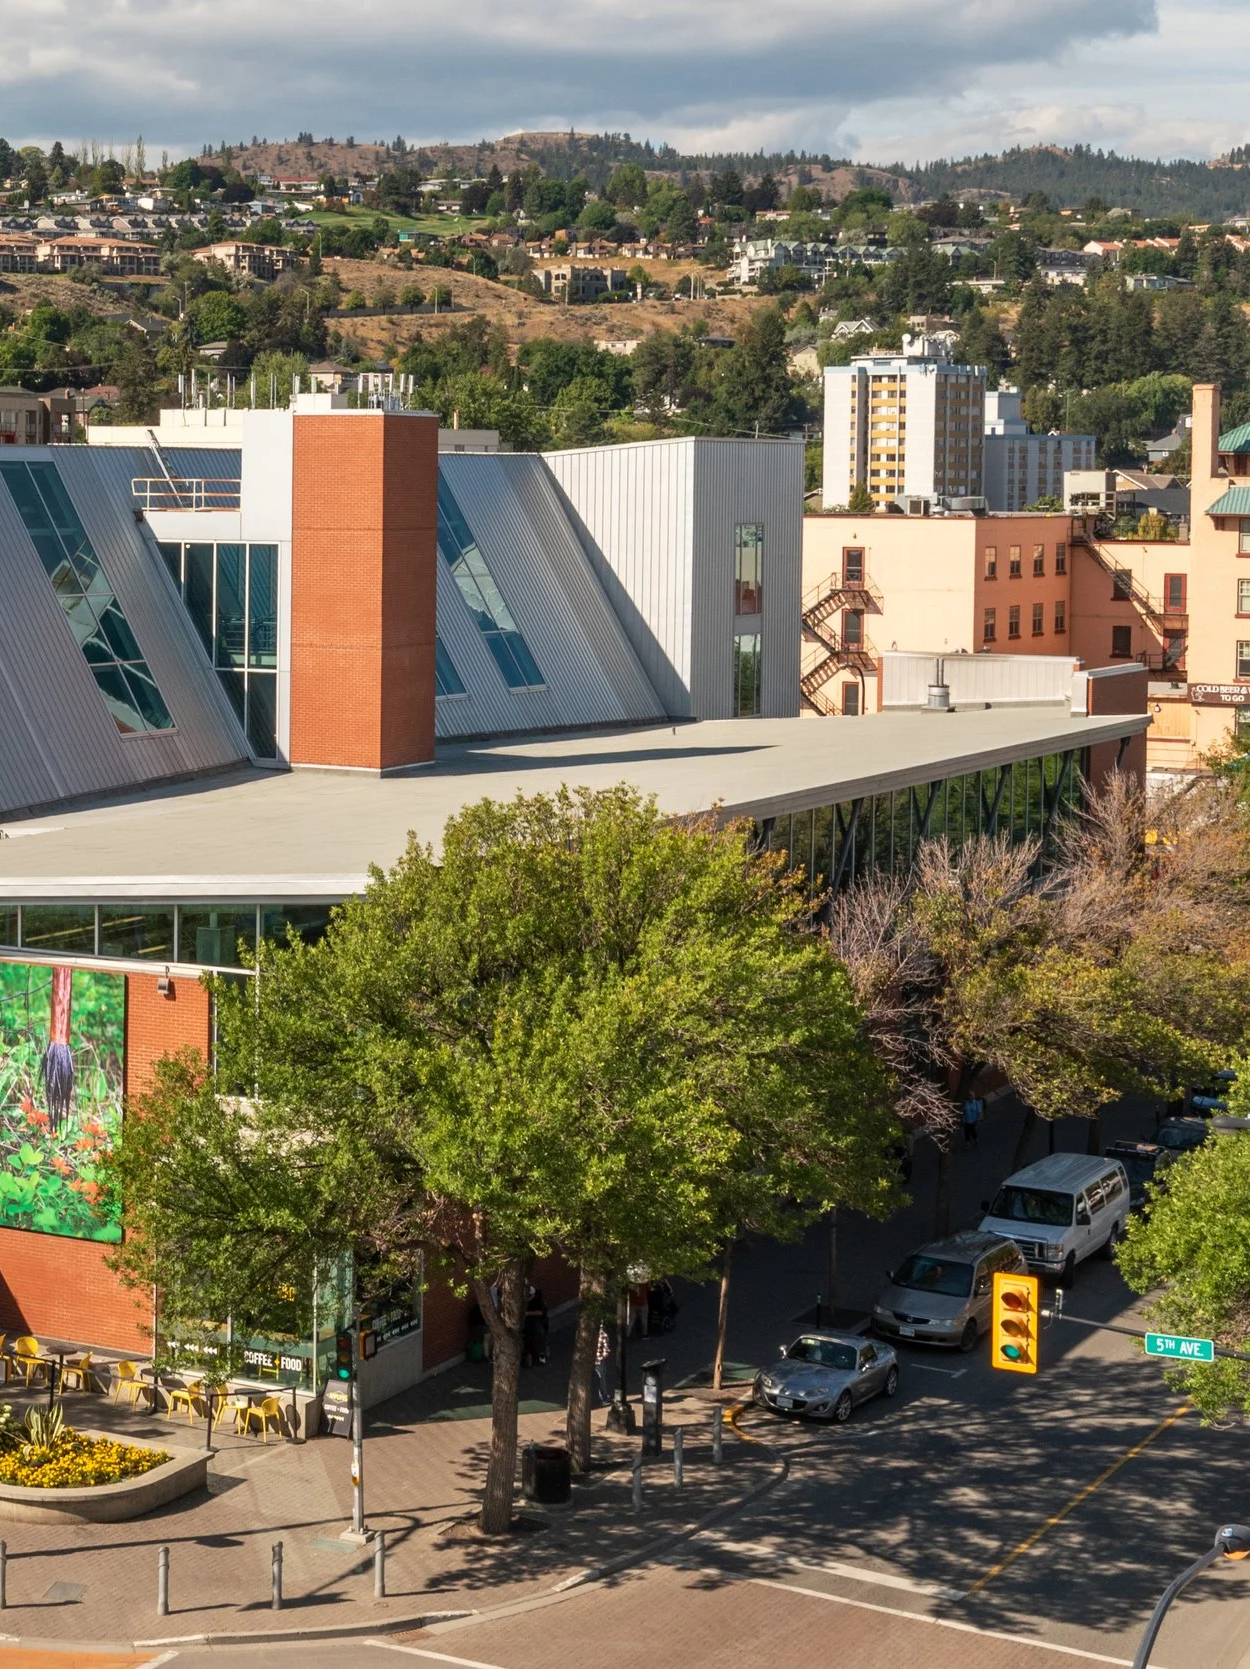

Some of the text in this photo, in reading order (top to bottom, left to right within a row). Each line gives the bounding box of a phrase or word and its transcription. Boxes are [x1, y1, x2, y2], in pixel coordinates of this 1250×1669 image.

[1196, 685, 1219, 693] COLD
[1220, 686, 1240, 694] BEER
[1220, 694, 1245, 702] TO GO
[1156, 1337, 1176, 1352] 5TH
[243, 1350, 273, 1367] COFFEE
[280, 1356, 302, 1371] FOOD
